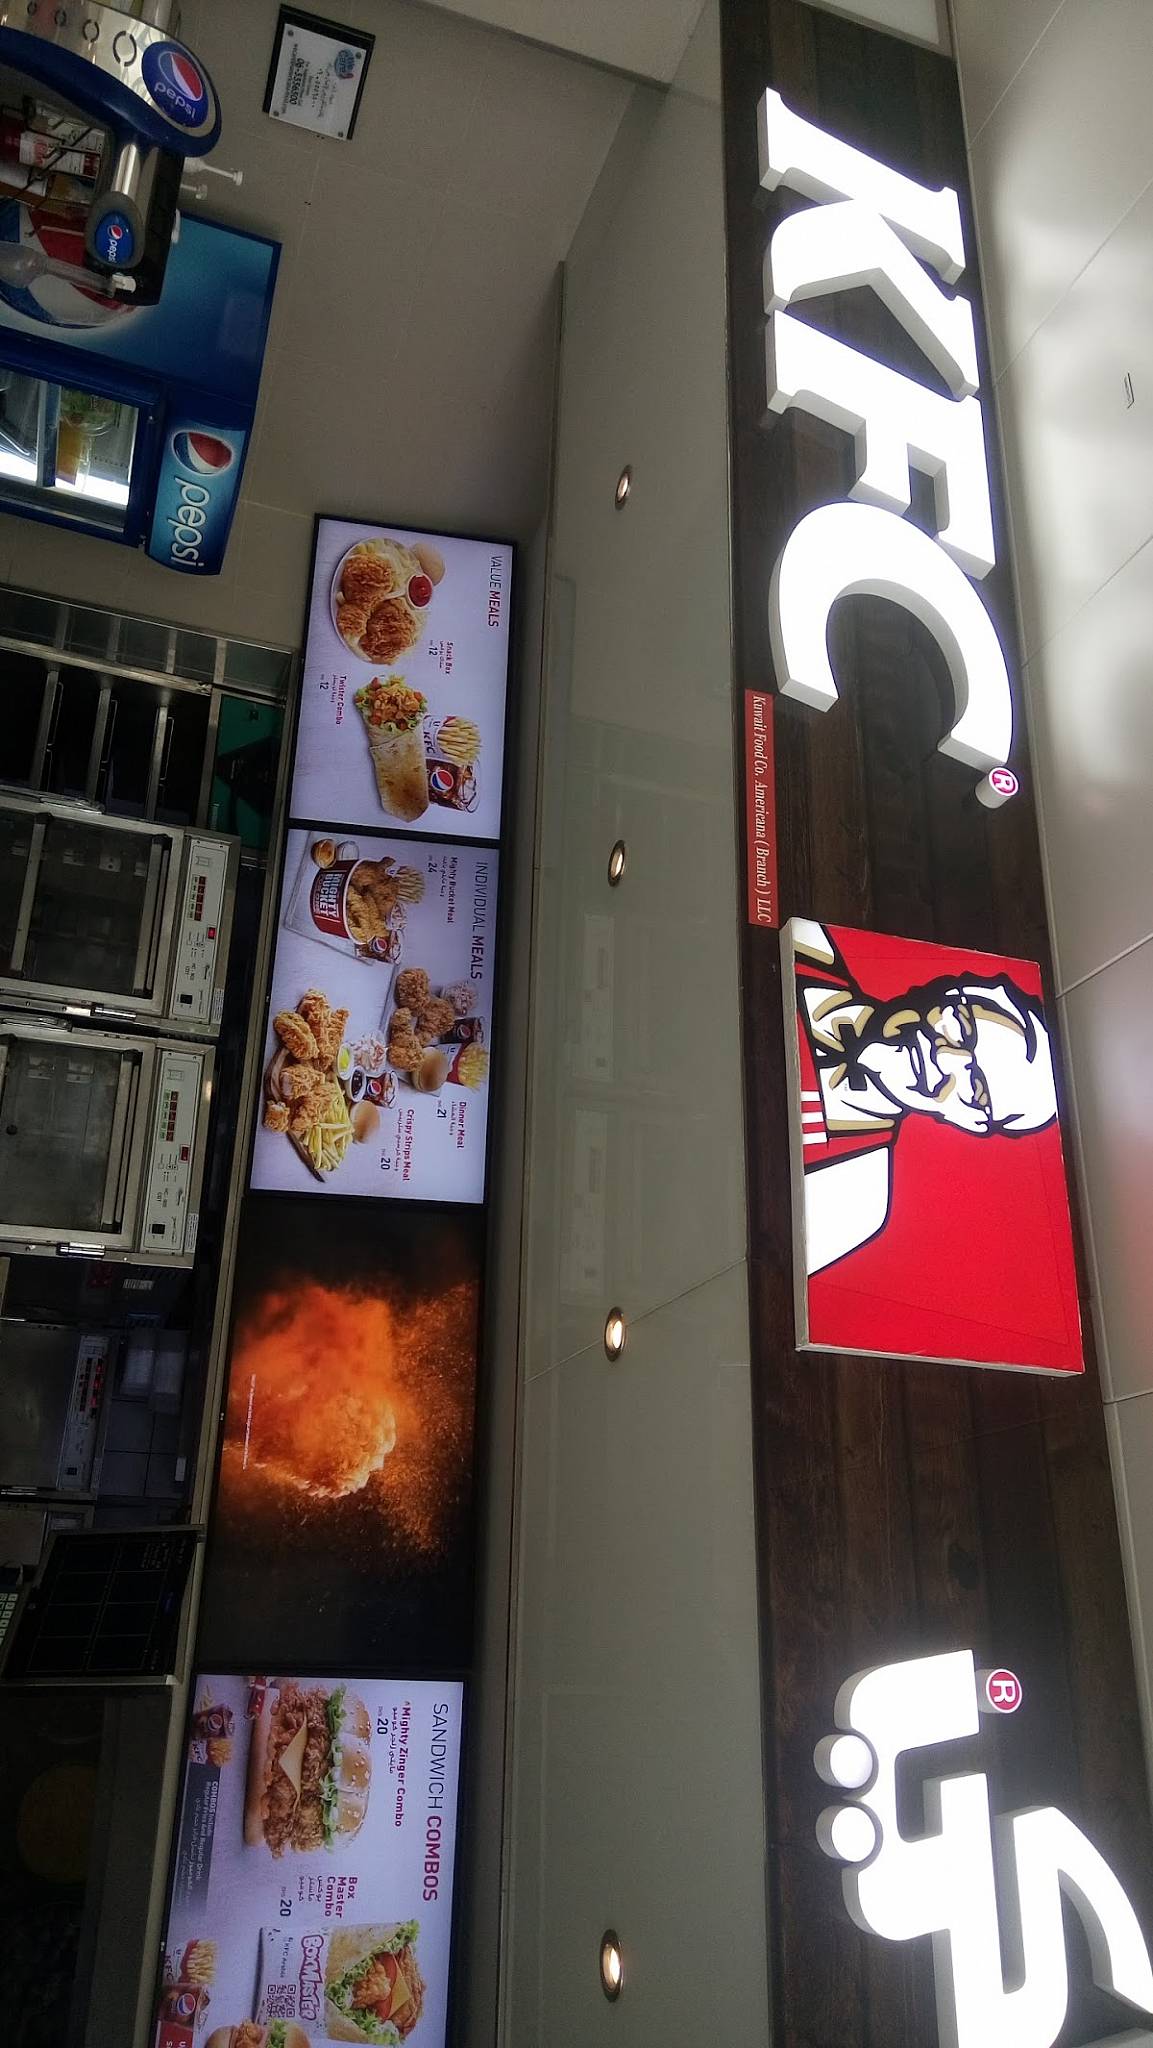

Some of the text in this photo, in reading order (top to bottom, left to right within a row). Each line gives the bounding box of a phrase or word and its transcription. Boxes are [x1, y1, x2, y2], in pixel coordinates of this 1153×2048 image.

[154, 82, 196, 120] pepsi
[106, 238, 119, 263] pepsi
[756, 88, 1013, 771] KFC
[167, 477, 210, 567] pepsi
[488, 555, 503, 627] VALUE MEALS
[428, 646, 438, 656] 12
[445, 641, 454, 675] Snack Box
[319, 681, 329, 690] 12
[335, 675, 347, 725] Twister Combo
[753, 695, 767, 731] Kuwait
[423, 731, 436, 754] KFC
[754, 732, 769, 759] Food
[754, 760, 768, 776] Co.
[754, 780, 770, 838] Americana
[427, 862, 438, 873] 24
[755, 848, 770, 887] Branch
[319, 873, 335, 917] BUCKET
[328, 873, 344, 918] MIGHTY
[447, 857, 458, 924] Mighty Bucket Meal
[470, 861, 489, 980] INDIVIDUAL MEALS
[757, 898, 772, 922] LLC
[436, 1109, 447, 1119] 21
[456, 1101, 467, 1149] Dinner Meal
[380, 1157, 391, 1170] 20
[402, 1109, 415, 1182] Crispy Strips Meal
[376, 1718, 389, 1735] 20
[396, 1747, 409, 1785] Zinger
[208, 1781, 219, 1813] COMBOS
[394, 1787, 406, 1827] Combo
[422, 1703, 449, 1901] SANDWICH COMBOS
[195, 1863, 203, 1881] Drink
[347, 1876, 358, 1899] Box
[279, 1899, 292, 1917] 20
[324, 1876, 336, 1917] Combo
[335, 1876, 347, 1919] Master
